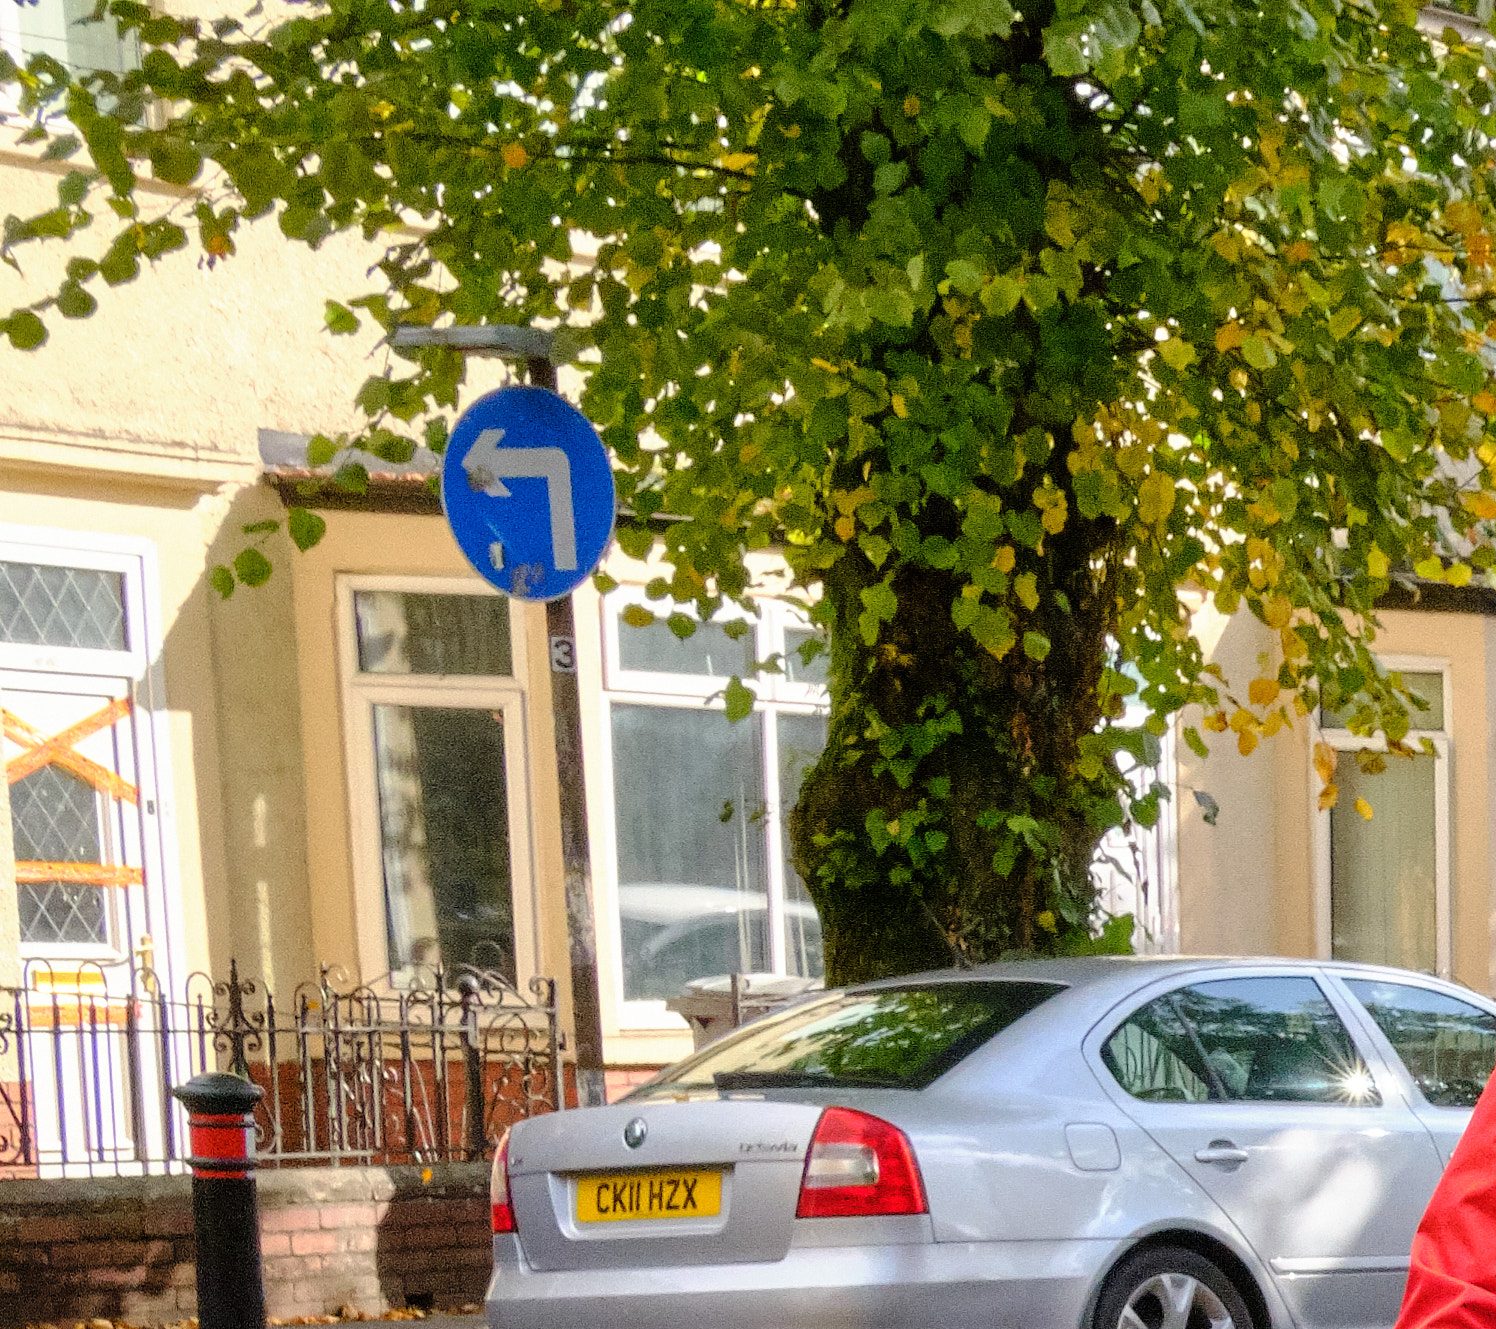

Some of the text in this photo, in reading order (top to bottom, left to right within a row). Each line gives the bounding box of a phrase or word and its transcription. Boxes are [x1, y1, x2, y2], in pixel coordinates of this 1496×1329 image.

[554, 640, 574, 668] 3
[597, 1178, 698, 1213] CK11 HZX
